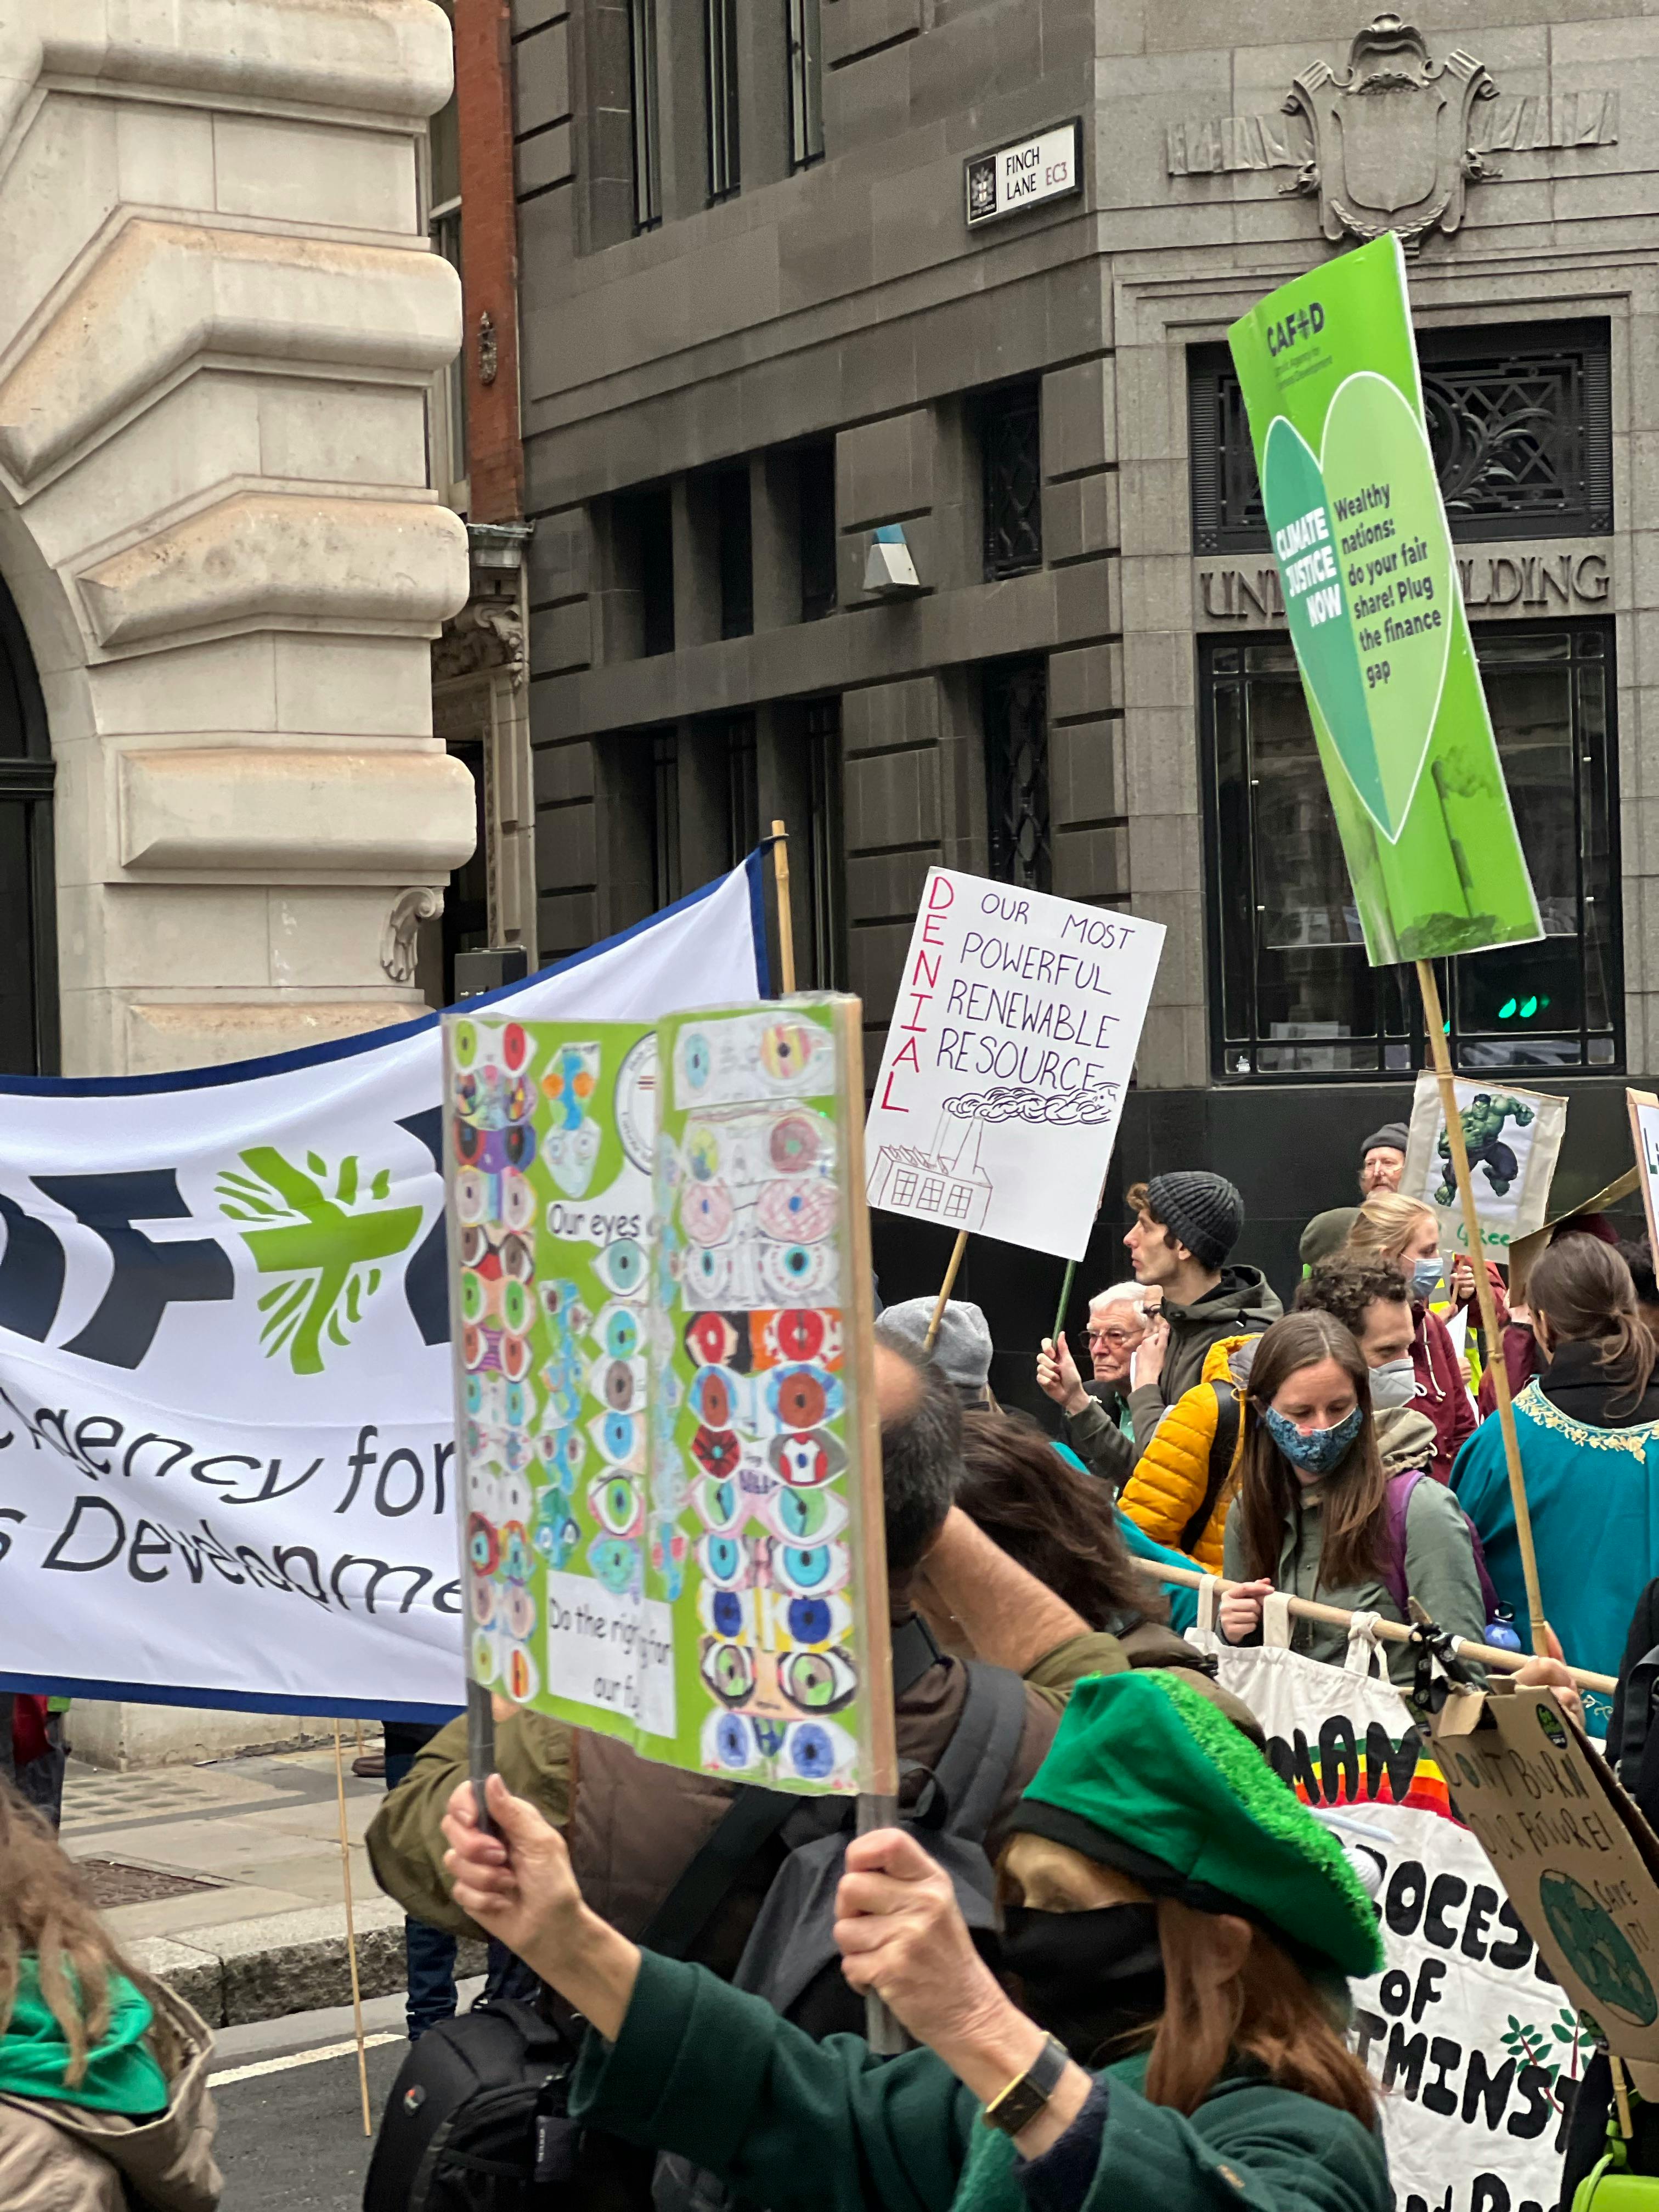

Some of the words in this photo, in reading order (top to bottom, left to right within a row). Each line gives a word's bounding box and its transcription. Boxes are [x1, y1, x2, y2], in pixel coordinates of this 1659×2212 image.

[1006, 146, 1040, 176] FINCH
[1007, 173, 1036, 200] LANE
[1046, 162, 1067, 185] EC3
[1333, 484, 1391, 522] Wealthy
[1276, 506, 1330, 561] CLIMATE
[1341, 518, 1396, 555] nations:
[1285, 545, 1337, 597] JUSTICE
[1348, 563, 1365, 586] do
[1366, 552, 1398, 585] your
[1401, 536, 1429, 567] fair
[1457, 554, 1610, 606] LDING
[1306, 583, 1342, 628] NOW
[1354, 585, 1396, 619] share!
[1397, 576, 1434, 603] Plug
[1359, 627, 1382, 652] the
[1384, 610, 1442, 644] finance
[1366, 660, 1391, 689] gap
[981, 893, 1029, 925] OUR
[1060, 913, 1136, 950] MOST
[960, 932, 1111, 995] POWERFUL
[881, 876, 954, 1113] DENIAL
[947, 979, 1120, 1048] RENEWABLE
[936, 1028, 1104, 1092] RESOURCE
[550, 1204, 585, 1234] Our
[590, 1214, 641, 1246] eyes
[333, 1425, 455, 1517] for
[549, 1597, 571, 1630] Do
[574, 1603, 606, 1638] the
[1508, 1749, 1590, 1800] BURN
[1469, 1813, 1525, 1860] OUR
[1379, 1957, 1447, 2024] OF
